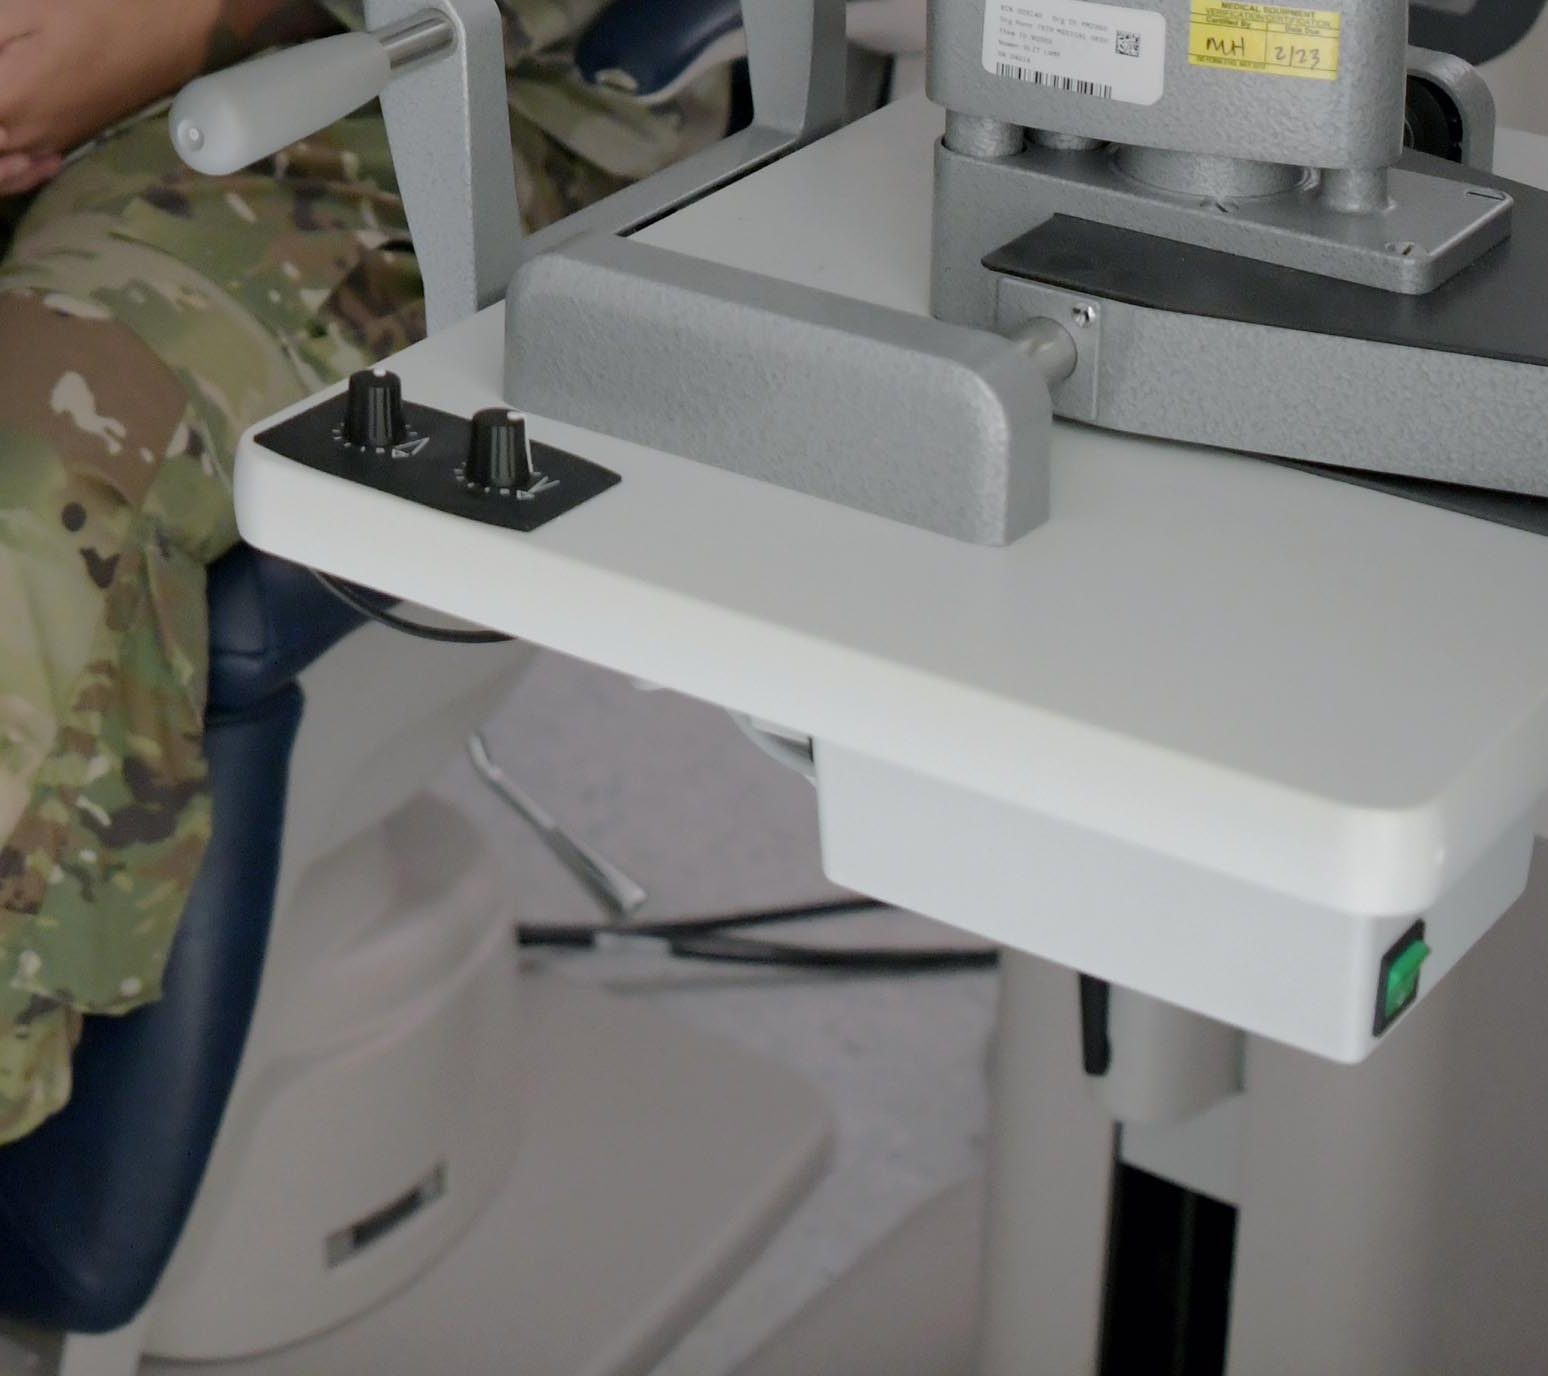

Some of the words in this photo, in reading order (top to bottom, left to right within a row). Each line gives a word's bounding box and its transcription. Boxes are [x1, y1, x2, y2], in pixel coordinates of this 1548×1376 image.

[1221, 2, 1259, 12] MEDICAL
[1263, 6, 1315, 18] EQUIPMENT
[1275, 46, 1321, 70] 2/23
